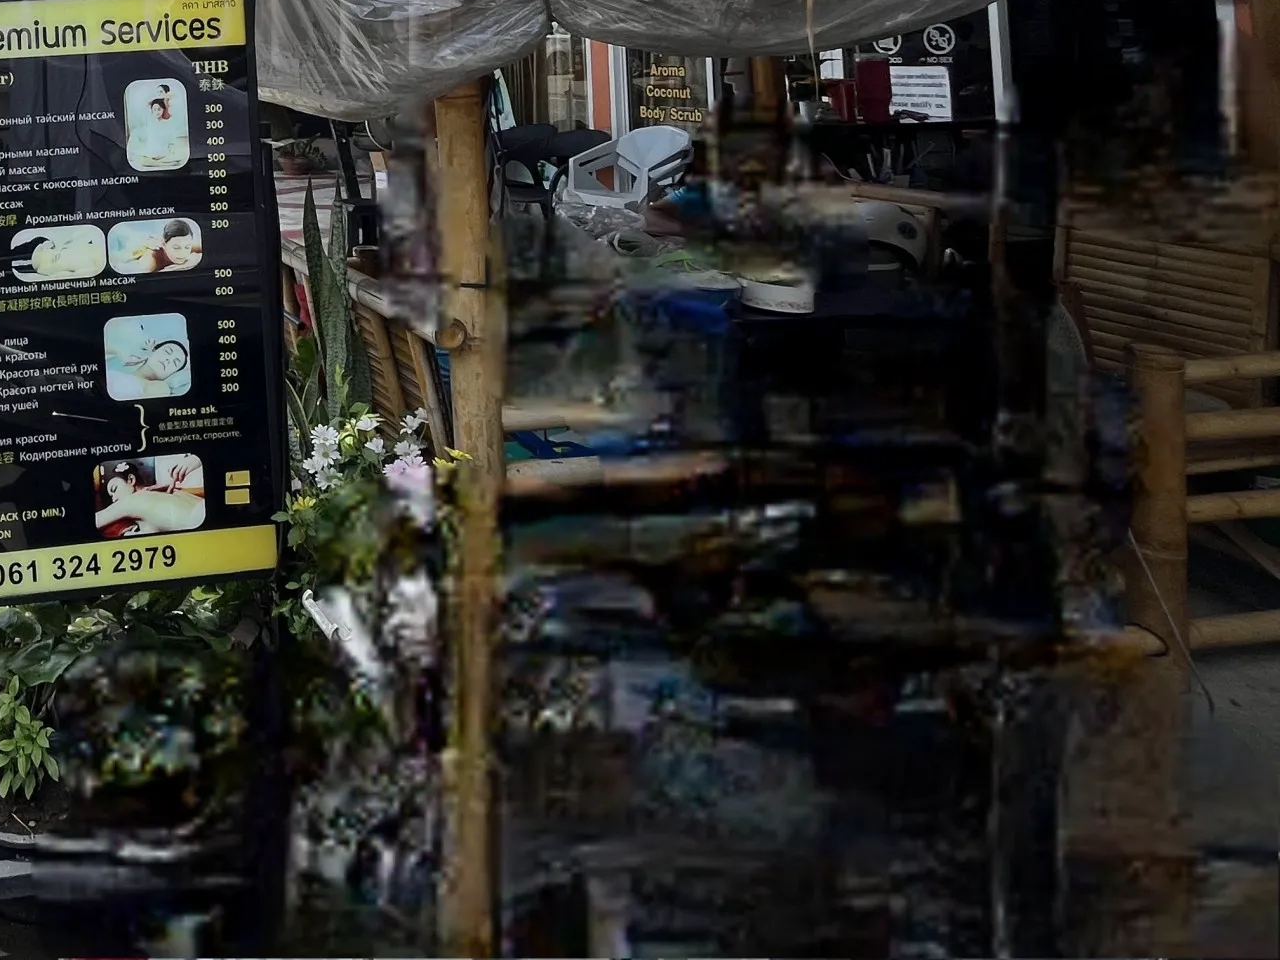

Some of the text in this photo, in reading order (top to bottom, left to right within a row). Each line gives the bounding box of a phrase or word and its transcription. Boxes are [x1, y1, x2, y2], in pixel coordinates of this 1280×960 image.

[100, 12, 221, 46] Services
[191, 59, 229, 75] THB
[650, 64, 685, 77] Aroma
[646, 85, 691, 99] Coconut
[205, 103, 223, 114] 300
[640, 106, 702, 122] Body Scrub
[35, 111, 76, 124] тайский
[78, 111, 115, 121] массаж
[206, 119, 224, 130] 300
[206, 136, 225, 146] 400
[36, 146, 79, 157] маслами
[207, 152, 226, 163] 500
[8, 165, 46, 175] массаж
[208, 169, 227, 179] 500
[42, 178, 98, 190] кокосовым
[101, 176, 139, 185] маслом
[209, 185, 228, 195] 500
[210, 201, 229, 212] 500
[25, 210, 83, 226] Ароматный
[85, 207, 136, 220] масляный
[138, 206, 176, 216] массаж
[211, 219, 229, 229] 300
[214, 268, 233, 278] 500
[39, 275, 92, 291] мышечный
[92, 272, 137, 287] массаж
[215, 286, 234, 296] 600
[217, 319, 236, 330] 500
[218, 334, 237, 344] 400
[5, 350, 47, 364] красоты
[219, 351, 238, 361] 200
[0, 368, 40, 381] Красота
[43, 363, 77, 376] ногтей
[80, 363, 99, 375] рук
[220, 367, 239, 378] 200
[39, 380, 74, 393] ногтей
[77, 380, 95, 389] ног
[221, 382, 240, 393] 300
[11, 399, 39, 413] ушей
[169, 404, 218, 417] Please ask.
[15, 433, 57, 447] красоты
[19, 447, 88, 462] Кодирование
[90, 443, 132, 456] красоты
[22, 510, 38, 522] (30
[41, 506, 66, 518] MIN.)
[52, 553, 102, 581] 324
[111, 544, 176, 574] 2979
